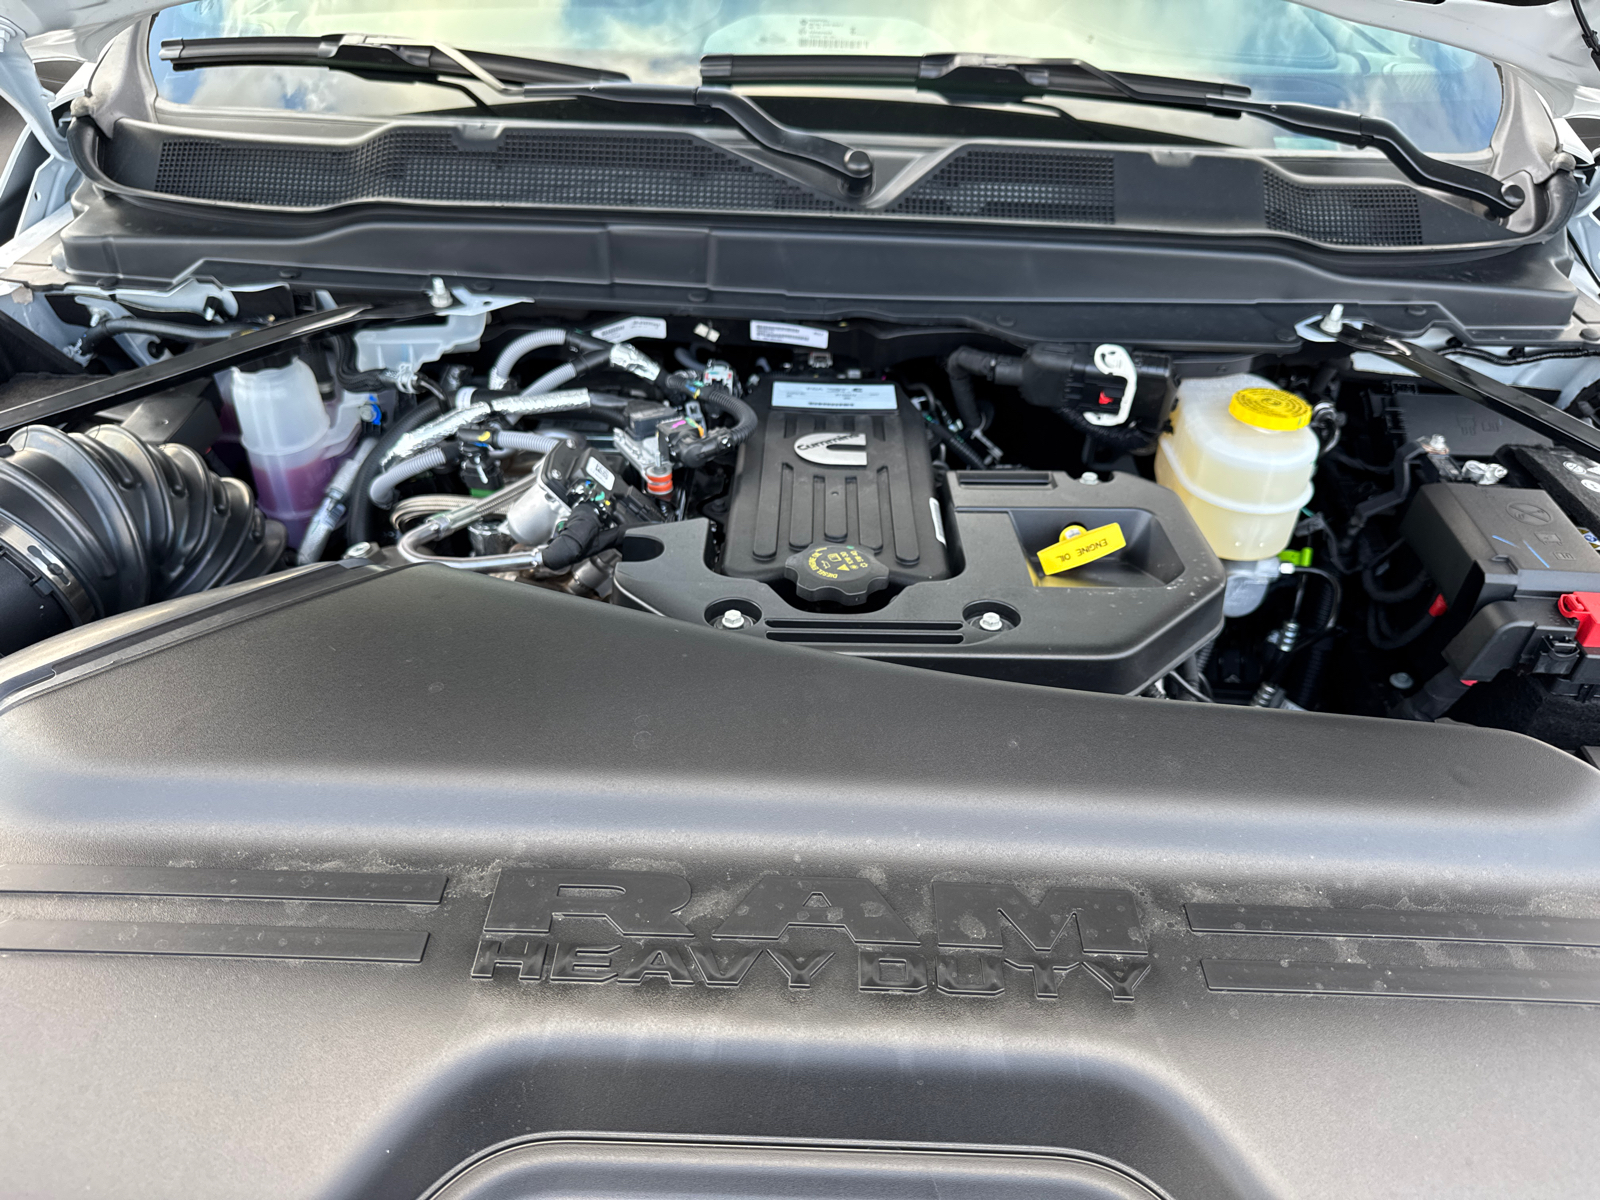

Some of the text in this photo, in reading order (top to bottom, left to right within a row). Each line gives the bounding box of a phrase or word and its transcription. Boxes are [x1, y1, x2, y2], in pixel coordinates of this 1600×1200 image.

[1055, 538, 1108, 563] ENGINE OIL
[483, 868, 1150, 957] RAM
[471, 940, 1152, 1001] HEAVY DUTY
